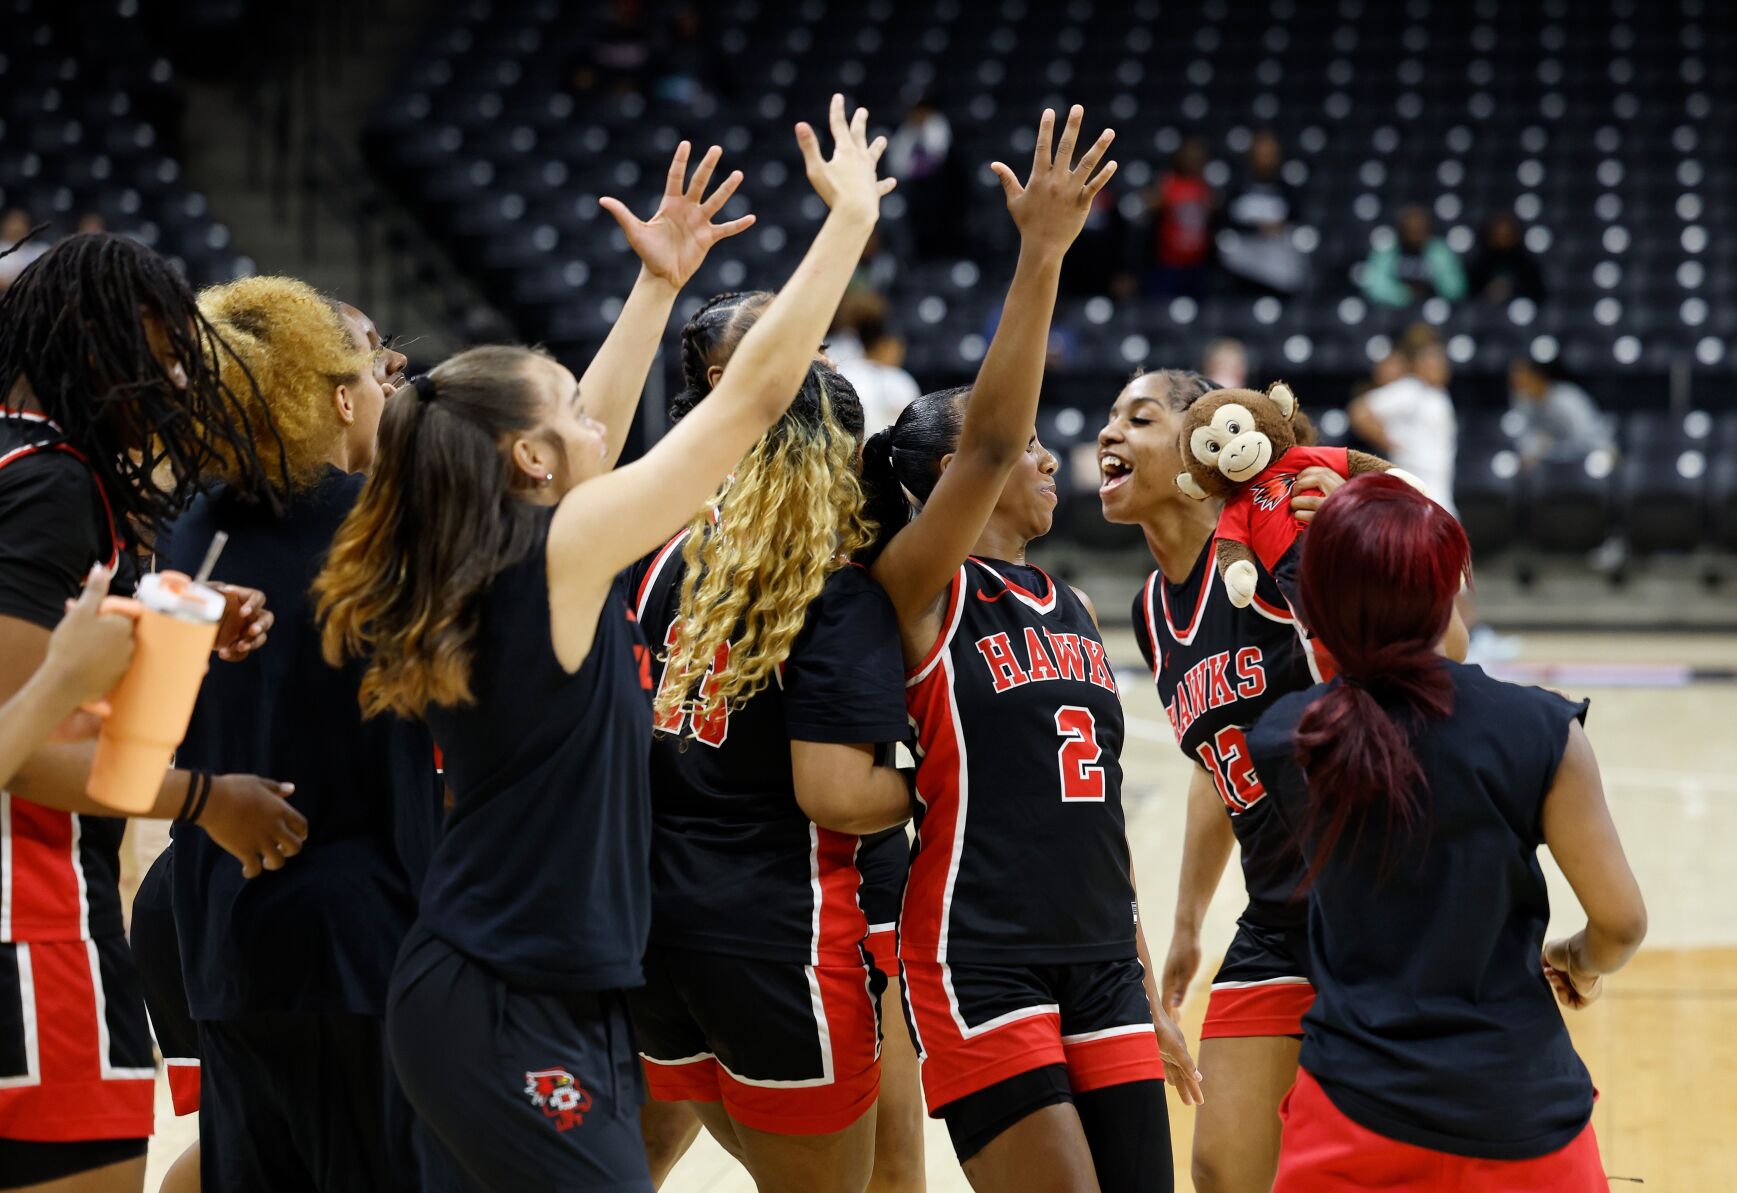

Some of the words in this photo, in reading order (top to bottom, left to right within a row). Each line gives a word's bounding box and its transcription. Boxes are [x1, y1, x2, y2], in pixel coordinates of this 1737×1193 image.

[975, 626, 1120, 702] HAWK
[1054, 705, 1105, 802] 2
[1196, 724, 1267, 816] 12
